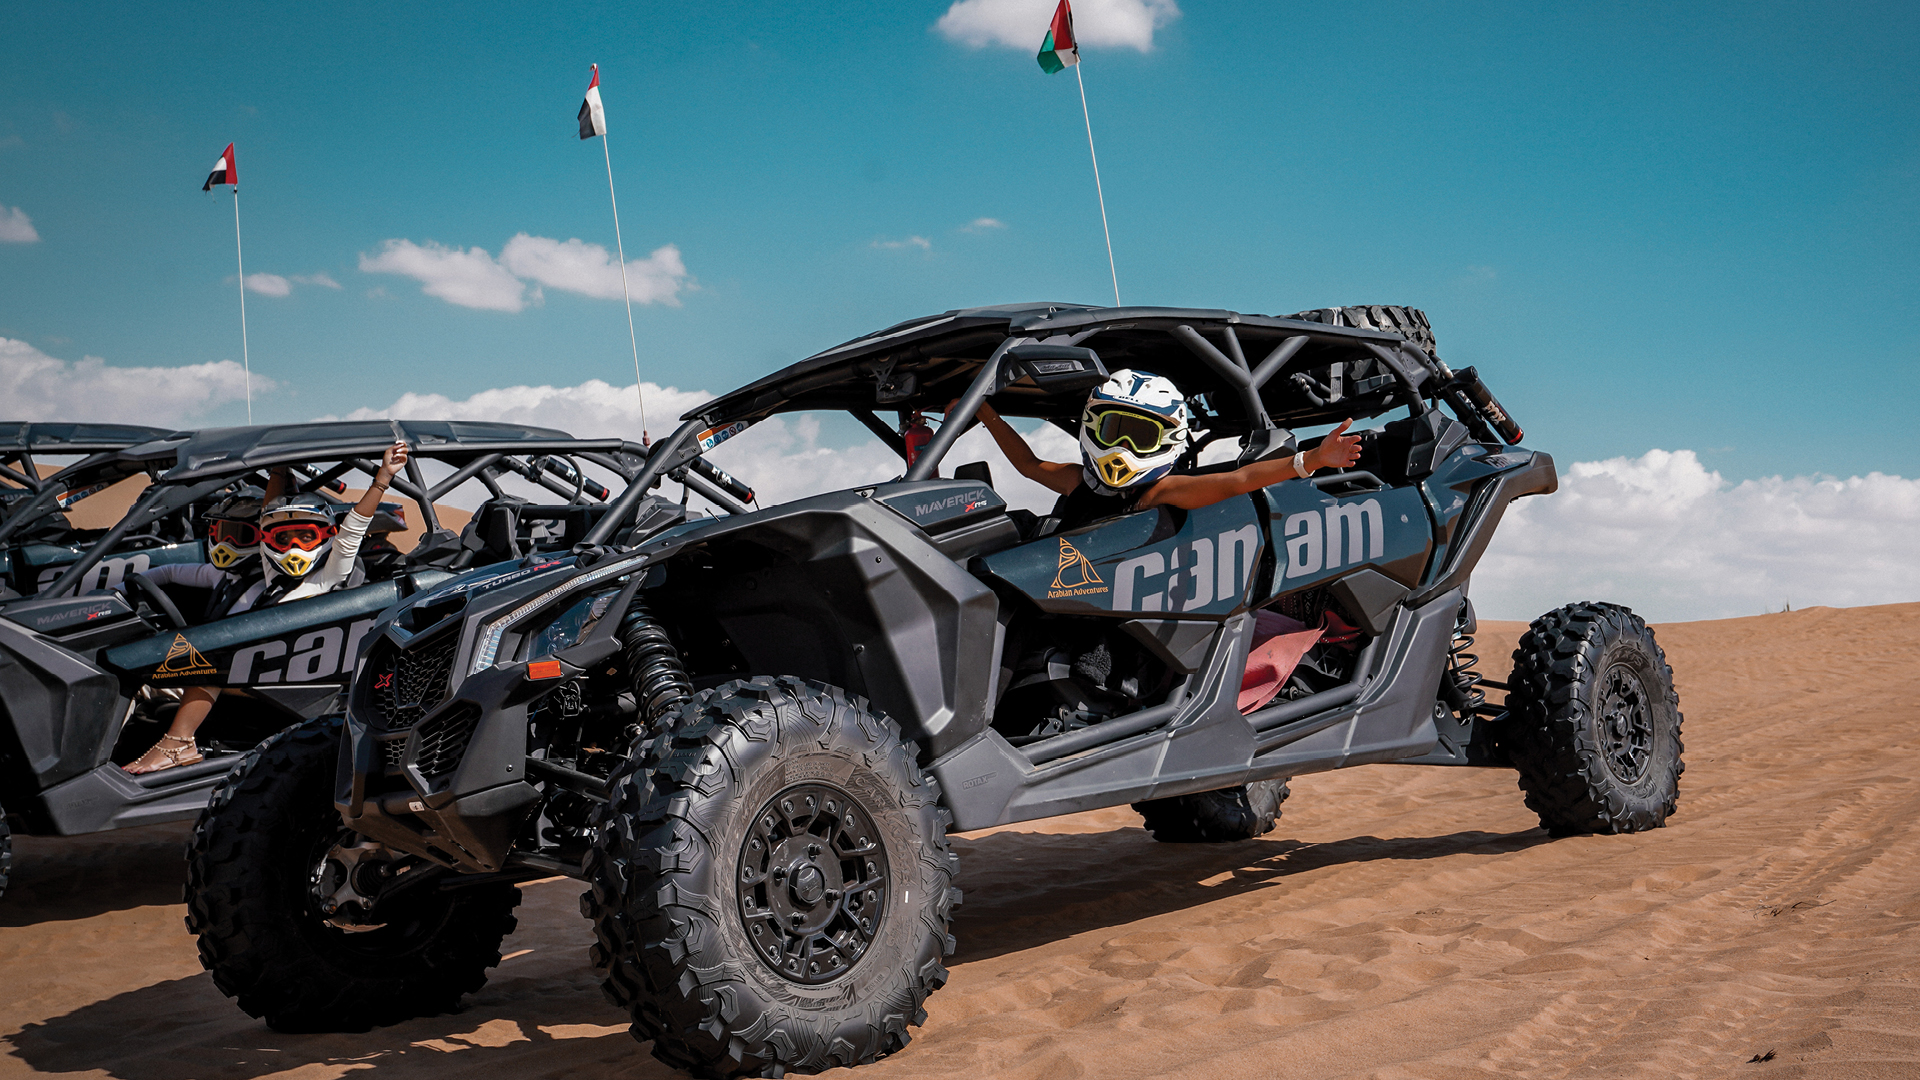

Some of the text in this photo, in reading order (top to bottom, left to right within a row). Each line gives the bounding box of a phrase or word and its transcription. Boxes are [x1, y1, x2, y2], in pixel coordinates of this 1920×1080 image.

[915, 488, 986, 517] MAVERICK
[1284, 498, 1384, 579] am
[482, 569, 531, 590] TURBO
[1047, 586, 1109, 599] Arabian Adventures
[36, 601, 112, 626] MAVERICK
[151, 667, 217, 680] Arabian Adventures
[962, 775, 988, 790] ROTAX
